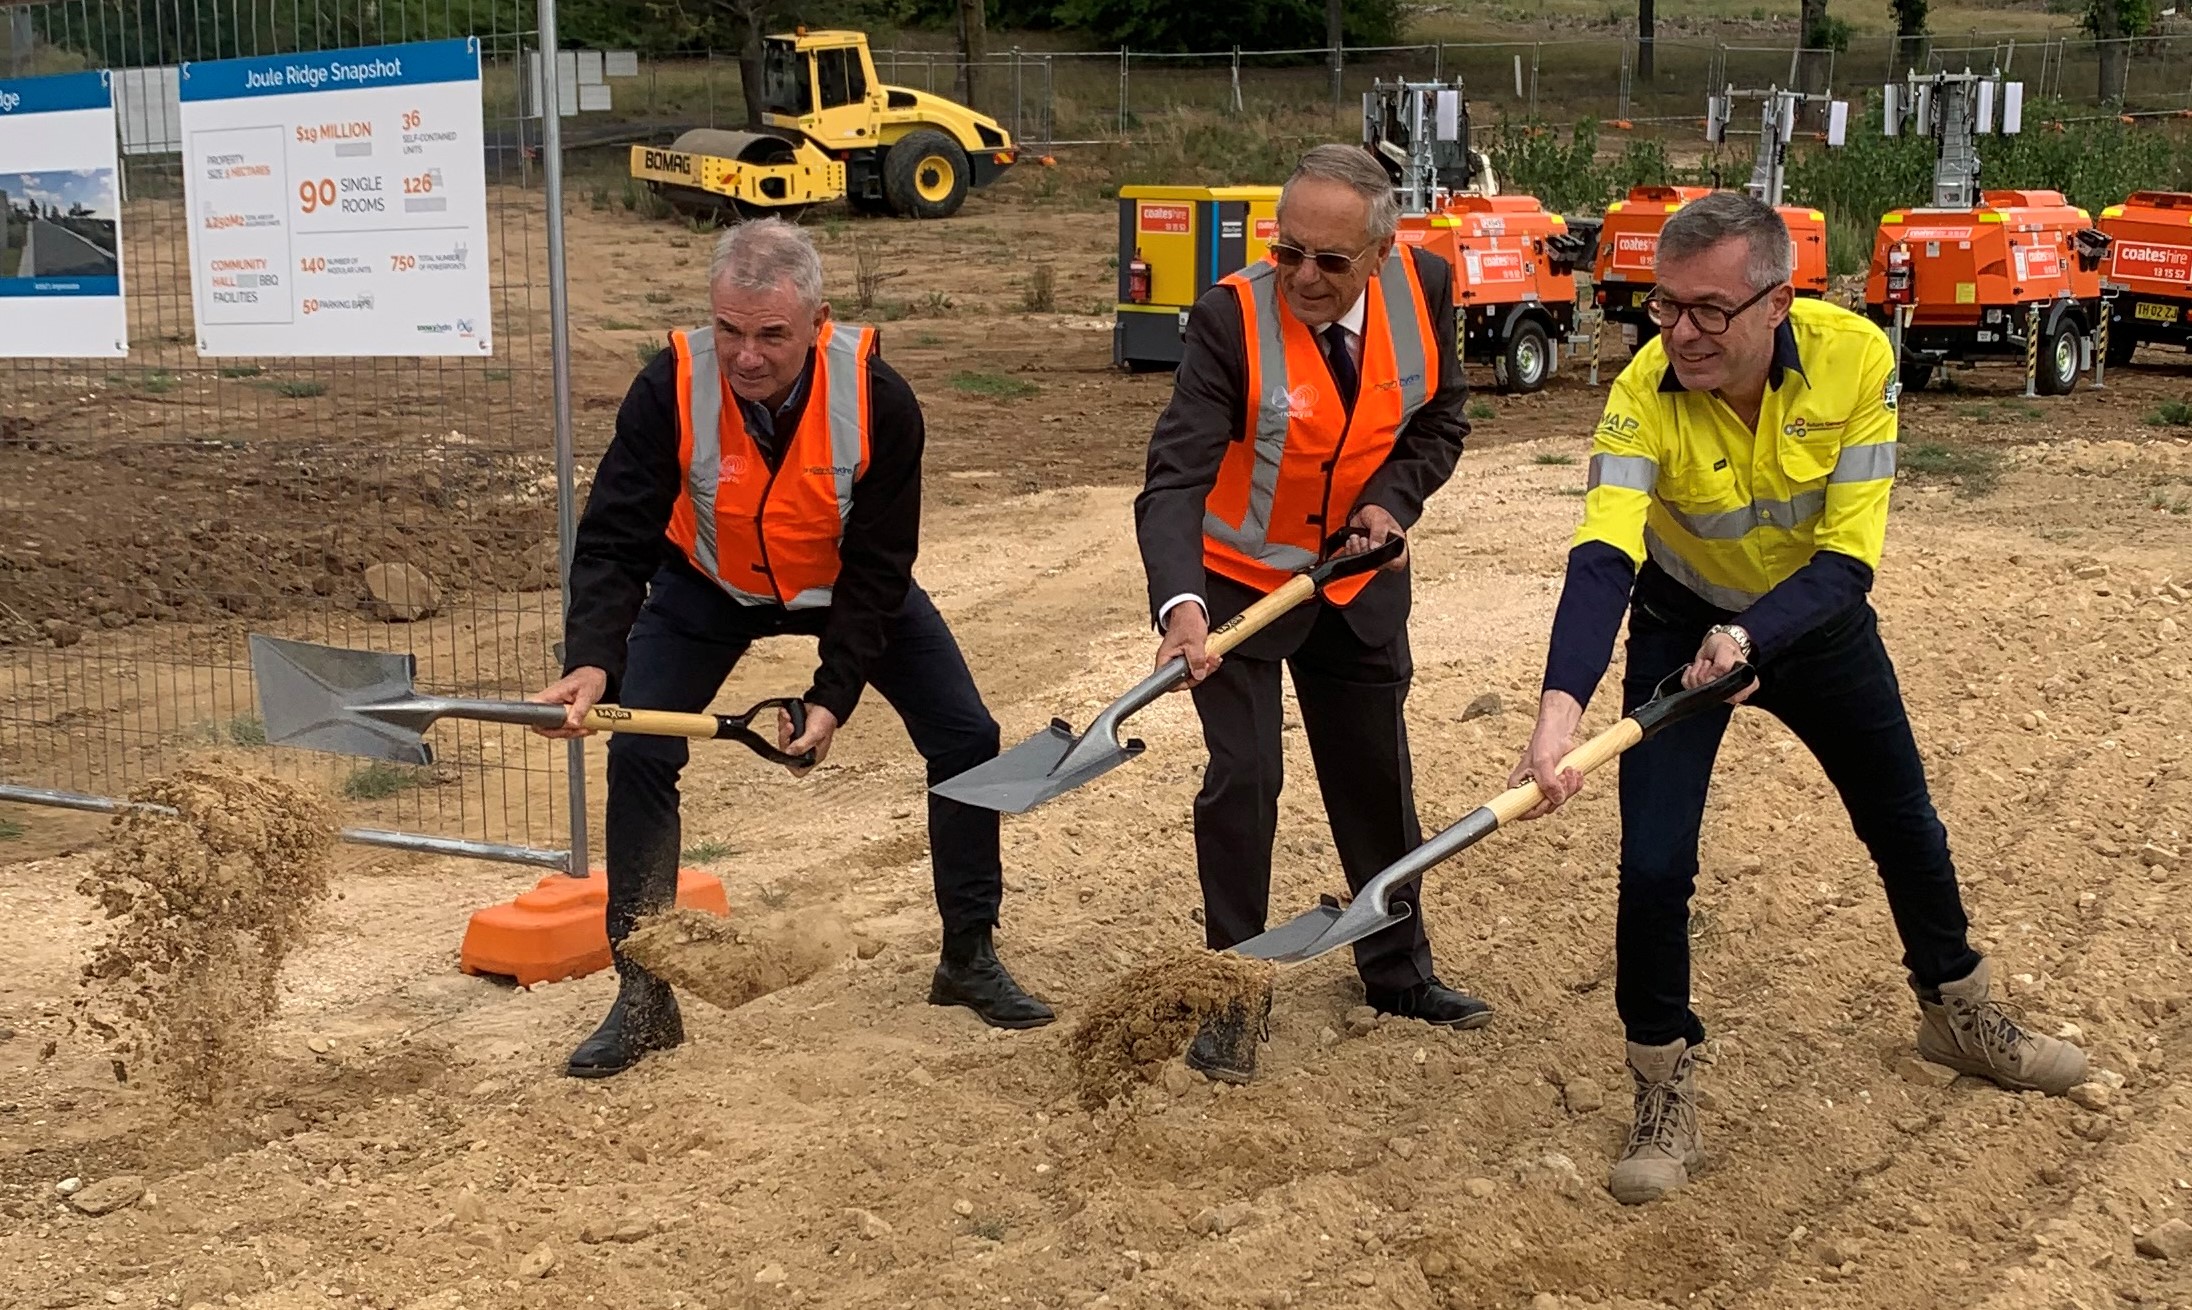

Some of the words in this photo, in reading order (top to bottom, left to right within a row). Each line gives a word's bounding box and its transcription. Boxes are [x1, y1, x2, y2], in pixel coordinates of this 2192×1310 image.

[245, 68, 283, 89] Joule
[286, 64, 328, 88] Ridge
[331, 57, 402, 83] Snapshot
[402, 110, 421, 131] 36
[296, 126, 317, 143] $19
[320, 121, 371, 140] MILLION
[403, 145, 422, 154] UNITS
[645, 150, 691, 175] BOMAG
[403, 174, 432, 194] 126
[299, 178, 336, 213] 90
[340, 176, 382, 192] SINGLE
[342, 197, 385, 213] ROOMS
[211, 259, 267, 271] COMMUNITY
[300, 256, 325, 273] 140
[390, 255, 415, 272] 750
[212, 276, 236, 287] HALL
[259, 274, 279, 286] BBQ
[2154, 267, 2163, 277] 13
[2174, 269, 2186, 279] 52
[213, 291, 258, 303] FACILITIES
[303, 299, 319, 314] 50
[320, 301, 350, 310] PARKING
[2137, 304, 2149, 315] TH
[2151, 305, 2162, 317] 02
